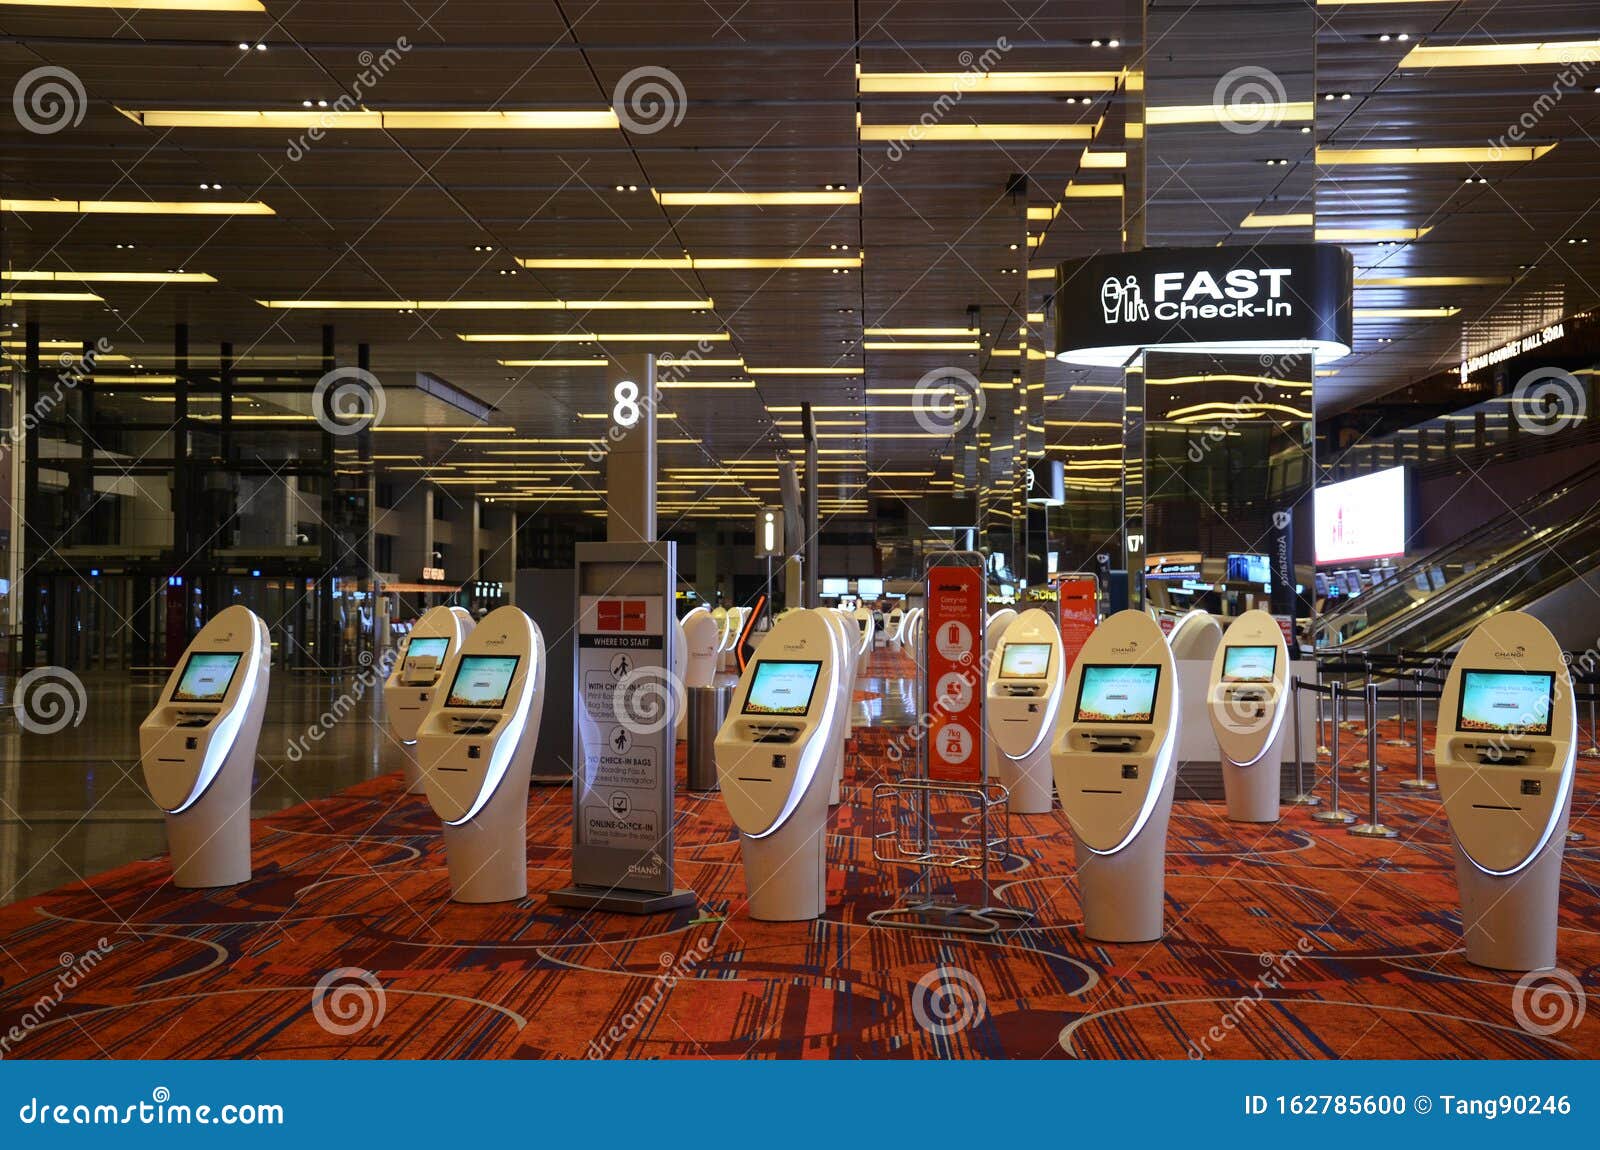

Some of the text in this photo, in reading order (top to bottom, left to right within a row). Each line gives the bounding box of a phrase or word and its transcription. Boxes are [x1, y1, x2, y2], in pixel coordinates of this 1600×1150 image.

[1153, 267, 1292, 303] FAST
[1153, 298, 1292, 321] Check-In
[1522, 334, 1542, 352] HALL
[1543, 323, 1565, 344] SORA
[613, 380, 640, 426] 8
[594, 637, 649, 647] WHERE TO START
[588, 682, 604, 691] WITH
[947, 728, 961, 739] 7kg
[600, 756, 632, 766] CHECK-IN
[633, 757, 652, 767] BAGS
[628, 864, 661, 876] CHANGI
